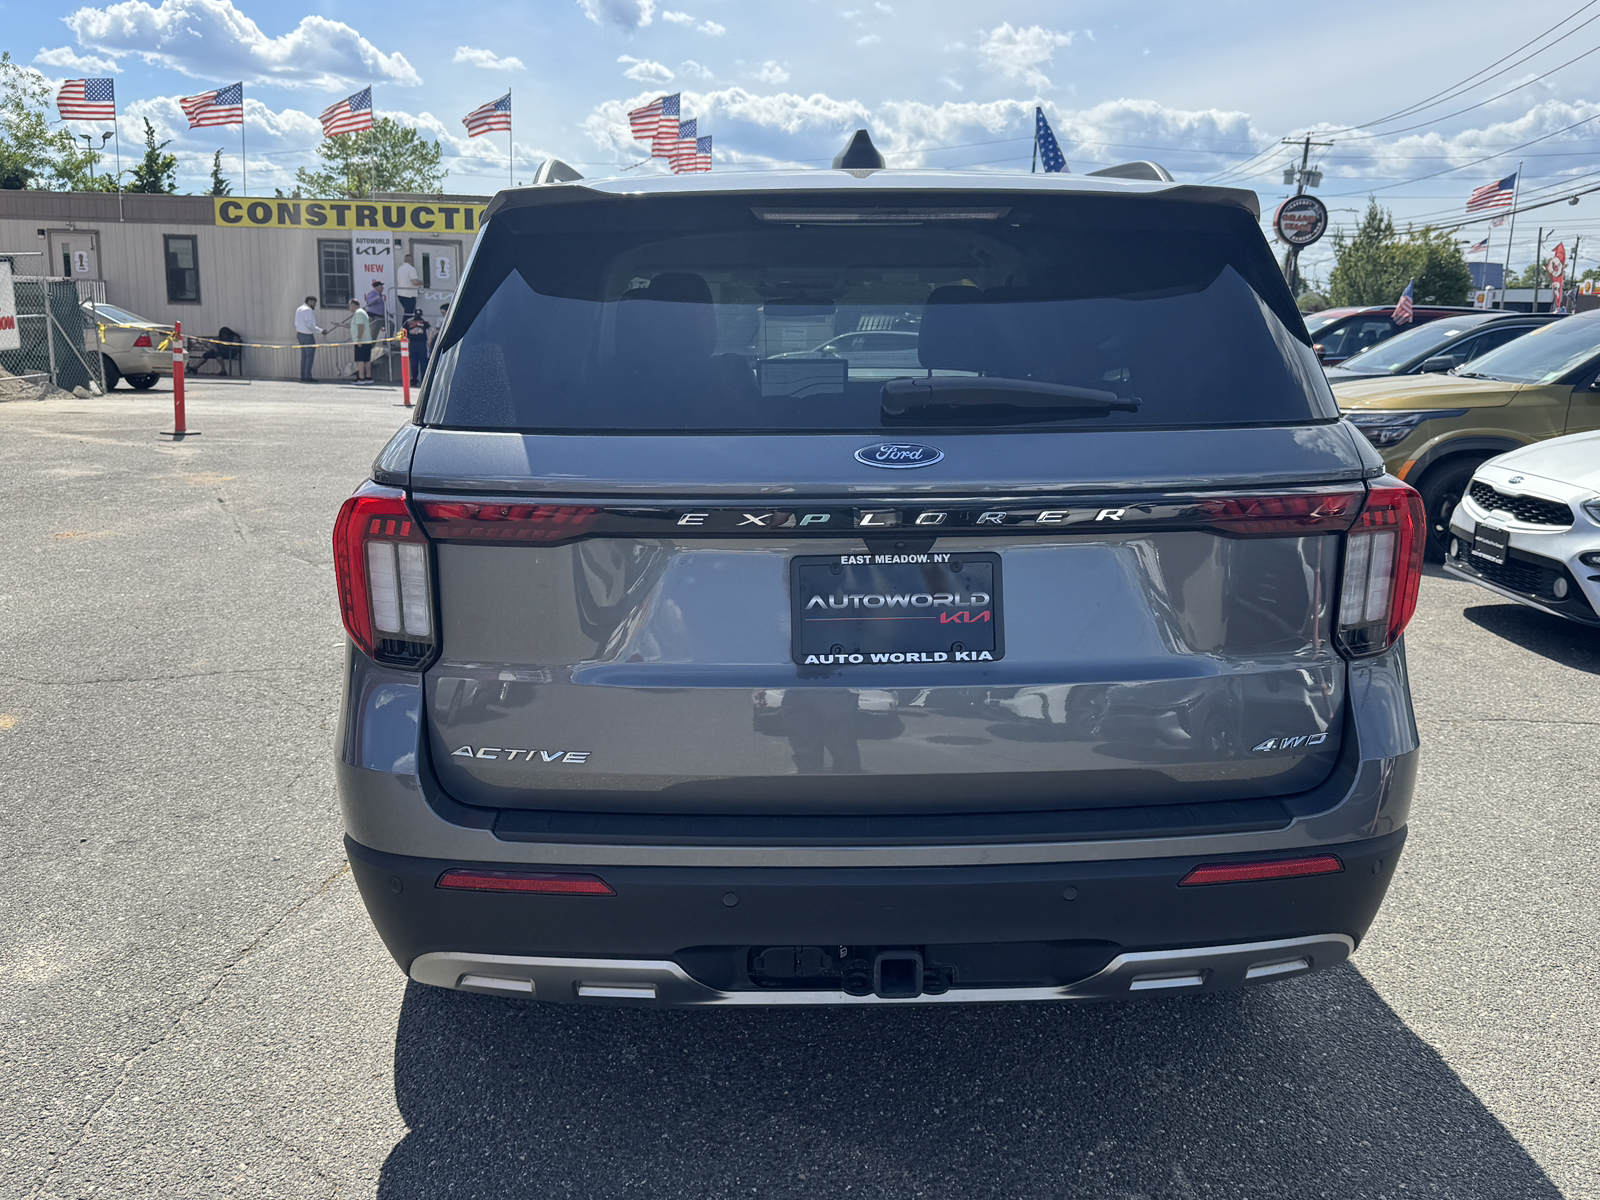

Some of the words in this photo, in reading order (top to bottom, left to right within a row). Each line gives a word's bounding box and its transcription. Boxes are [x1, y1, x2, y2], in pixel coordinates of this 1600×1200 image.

[219, 200, 483, 229] CONSTRUCTI
[356, 246, 391, 256] KIA
[364, 263, 384, 273] NEW
[874, 442, 924, 462] Ford
[676, 507, 1126, 526] EXPLORER
[840, 555, 872, 565] EAST
[934, 553, 951, 563] NY
[805, 592, 990, 610] AUTOWORLD
[939, 610, 991, 624] KIA
[804, 653, 864, 665] AUTO
[870, 651, 948, 663] WORLD
[955, 650, 994, 661] KIA
[1252, 732, 1329, 752] 4WD
[451, 745, 592, 764] ACTIVE
